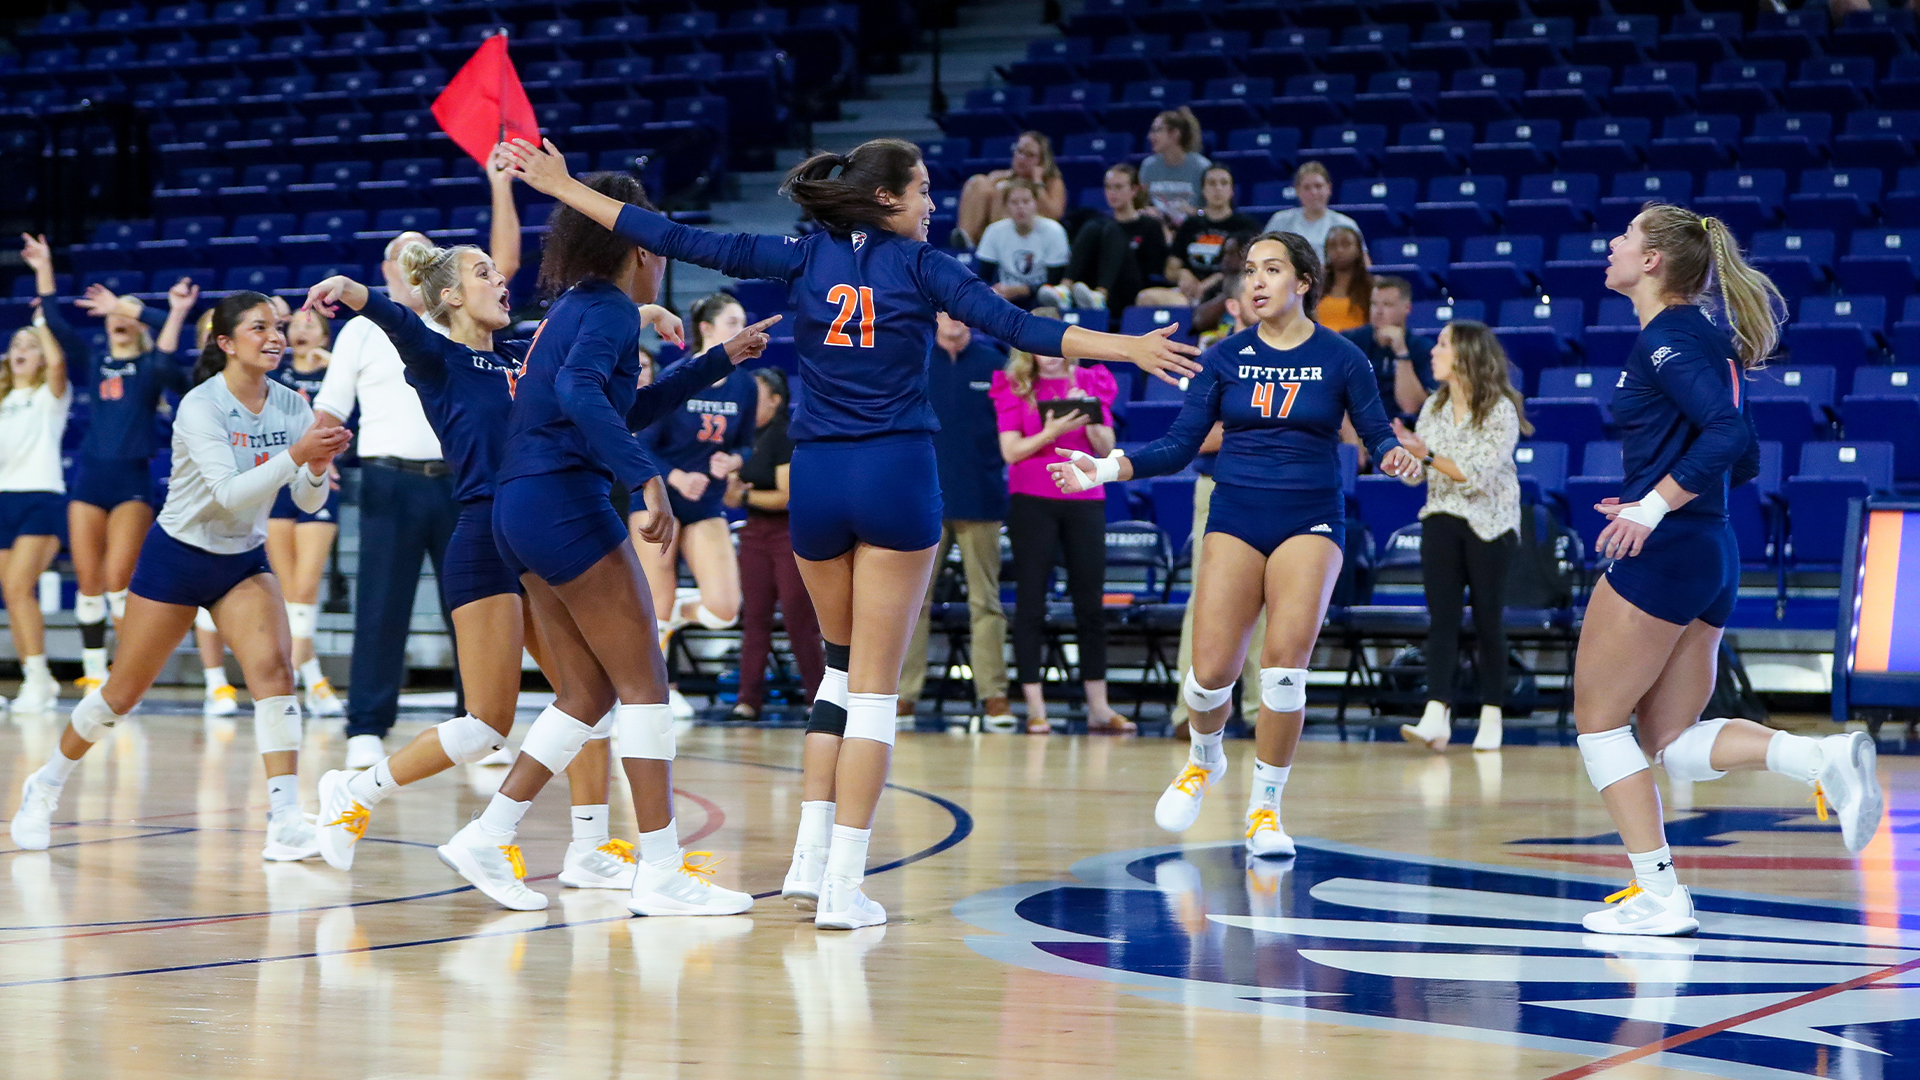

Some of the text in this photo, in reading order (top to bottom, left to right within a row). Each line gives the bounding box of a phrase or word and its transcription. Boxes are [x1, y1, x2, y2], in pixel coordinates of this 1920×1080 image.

[824, 284, 875, 348] 21
[1250, 381, 1302, 418] 47
[696, 412, 727, 443] 32
